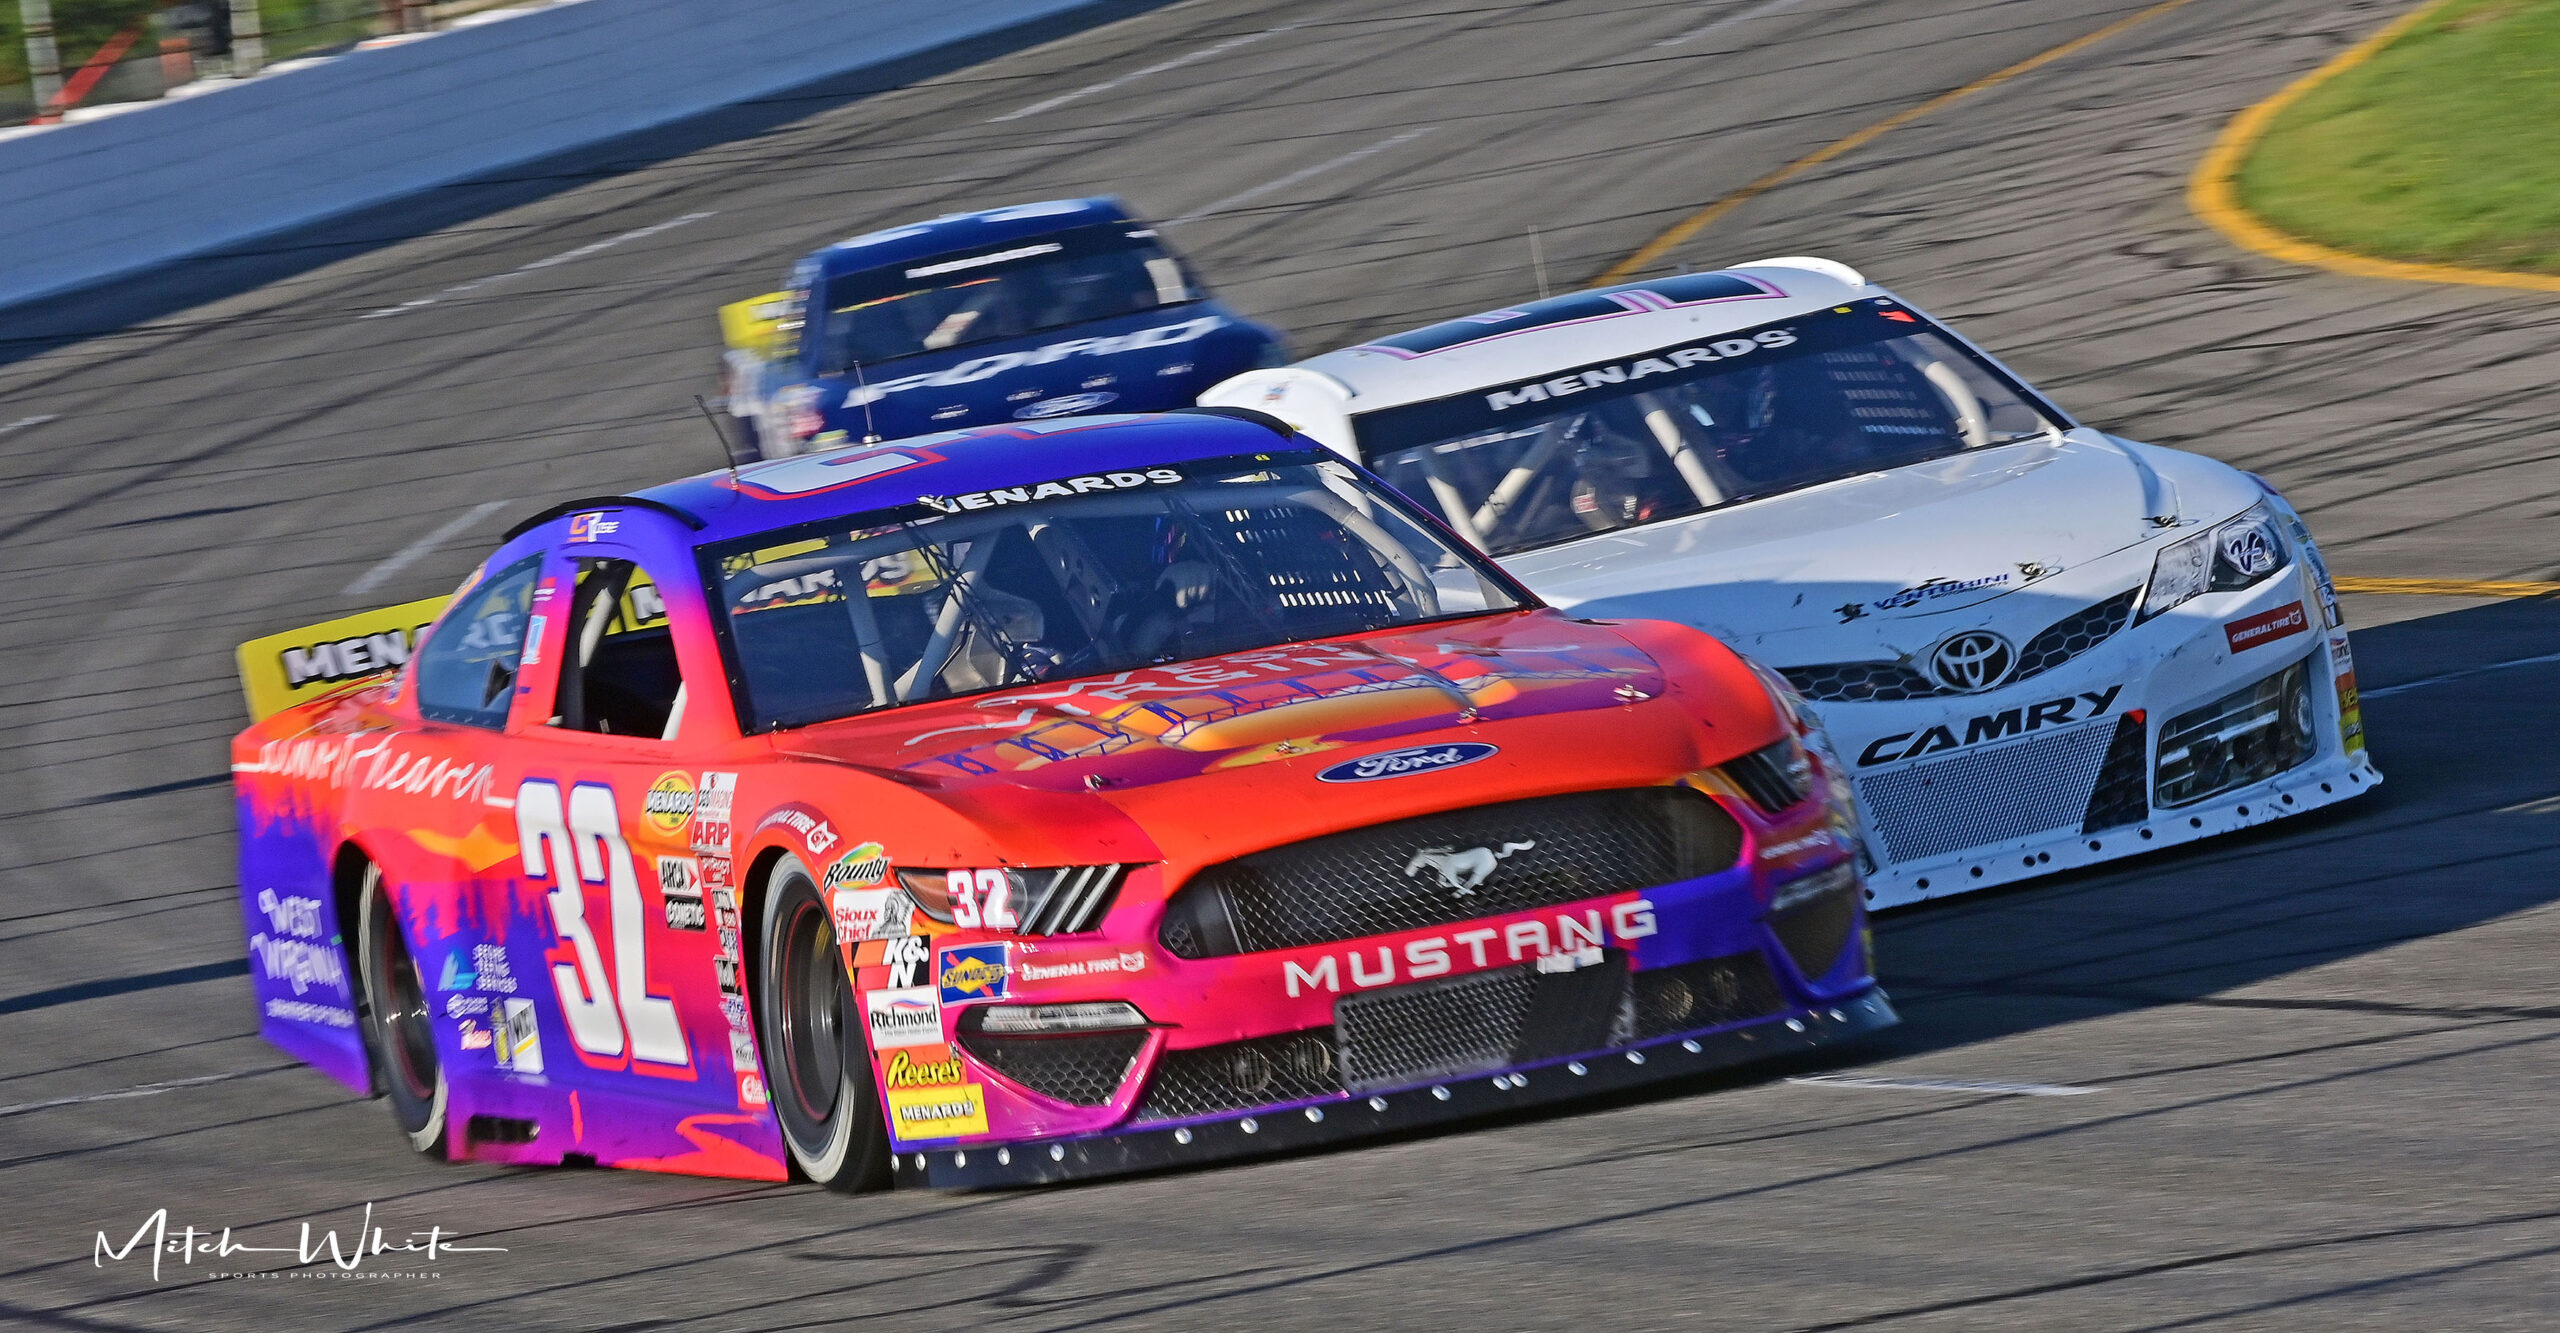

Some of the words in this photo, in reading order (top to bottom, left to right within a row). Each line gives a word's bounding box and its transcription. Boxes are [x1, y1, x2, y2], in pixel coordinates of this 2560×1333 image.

[1486, 329, 1798, 411] MENARDS
[1873, 574, 2009, 611] VENTURINI
[2232, 623, 2272, 643] GENERAL
[2272, 618, 2290, 631] TIRE
[1857, 684, 2123, 767] CAMRY
[1354, 748, 1464, 778] Ford
[693, 821, 729, 846] ARP
[824, 858, 889, 894] Bounty
[947, 868, 1019, 929] 32
[515, 780, 692, 1067] 32
[836, 907, 878, 922] Sioux
[838, 923, 872, 942] Chief
[1283, 899, 1659, 998] MUSTANG
[942, 963, 1006, 988] SUNOCO
[1022, 963, 1086, 981] GENERAL
[1086, 958, 1120, 975] TIRE
[870, 1002, 937, 1029] Richmond
[887, 1051, 962, 1089] Reese's
[900, 1101, 975, 1121] MENARDS
